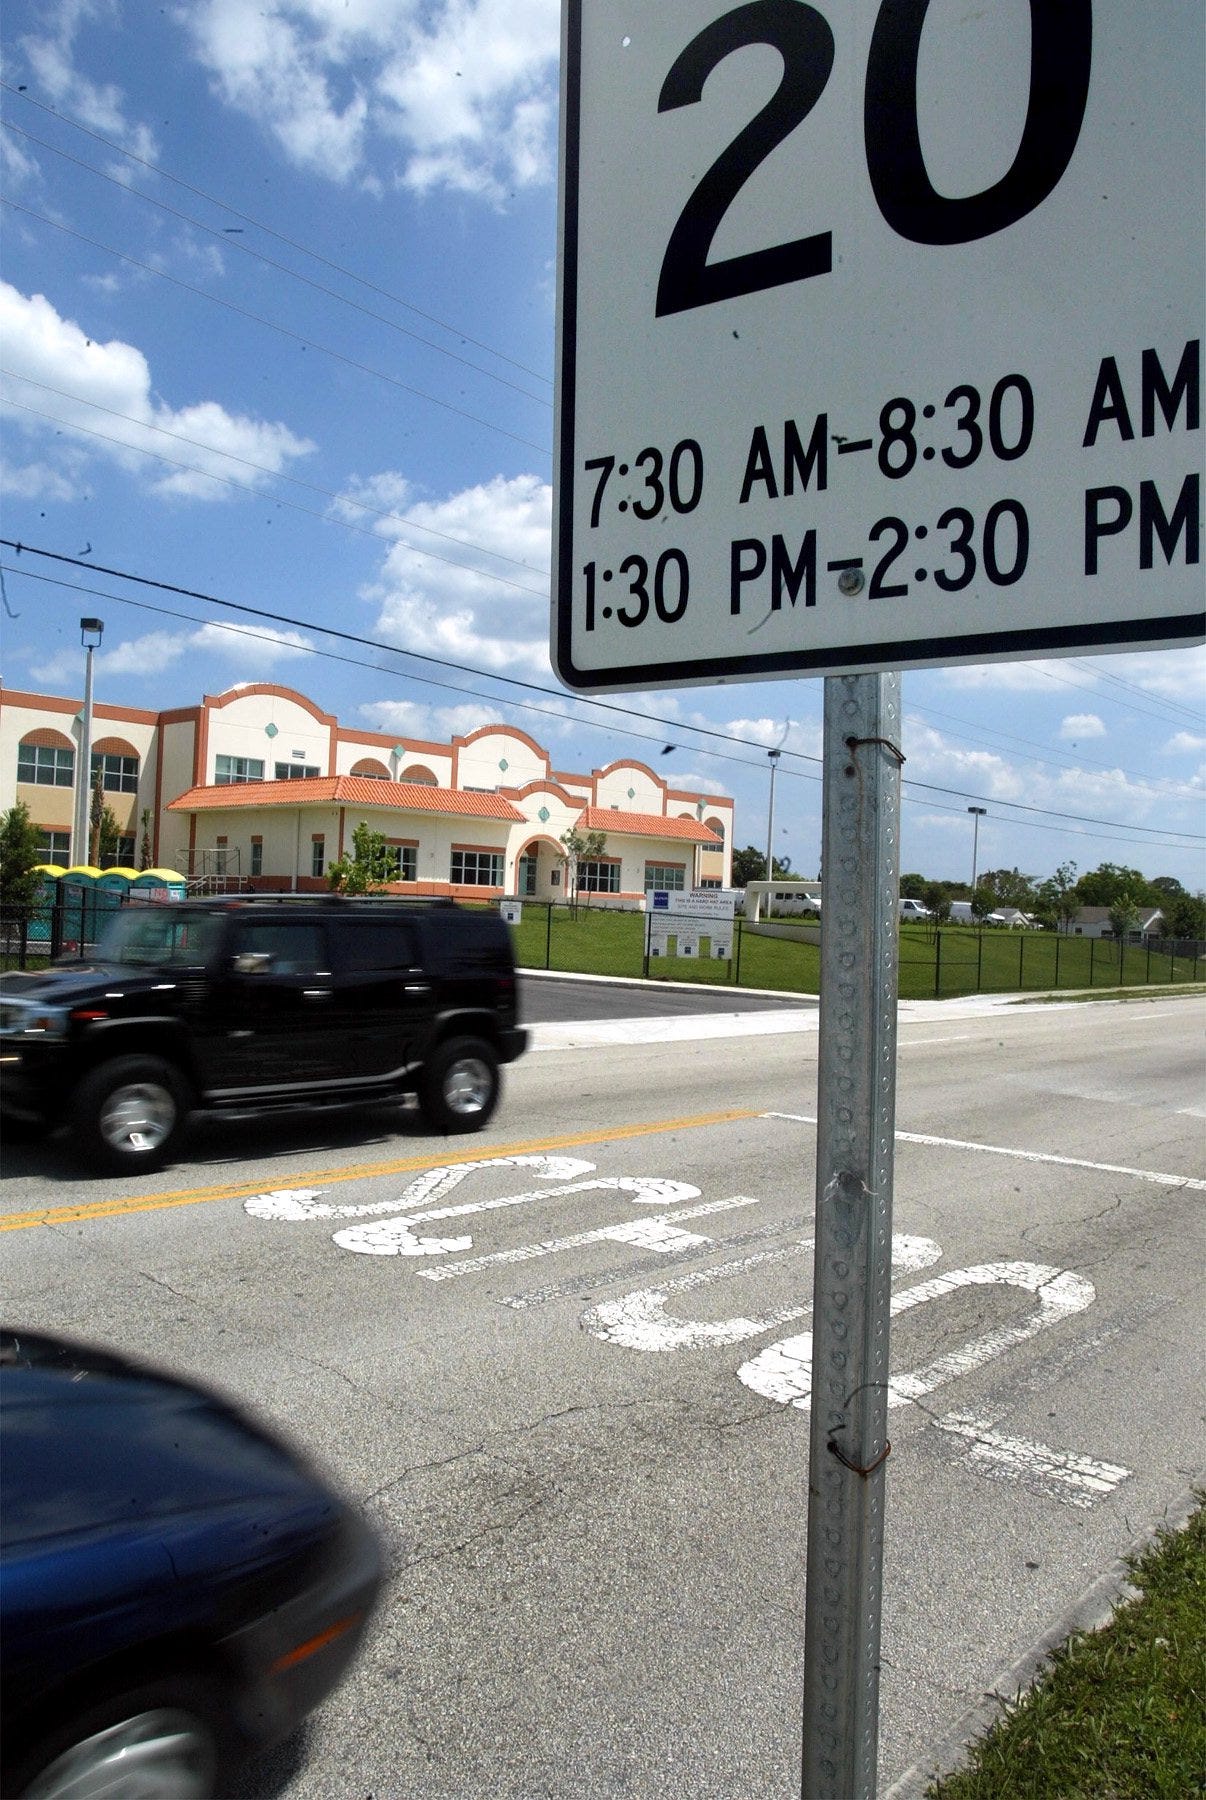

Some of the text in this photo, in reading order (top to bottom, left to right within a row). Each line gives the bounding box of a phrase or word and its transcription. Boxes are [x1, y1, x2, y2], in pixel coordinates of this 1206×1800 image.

[655, 0, 1094, 318] 20
[582, 547, 690, 631] 1:30
[1084, 472, 1201, 576] PM
[584, 438, 704, 528] 7:30
[1081, 338, 1201, 448] AM
[243, 1154, 1174, 1509] SCHOOL
